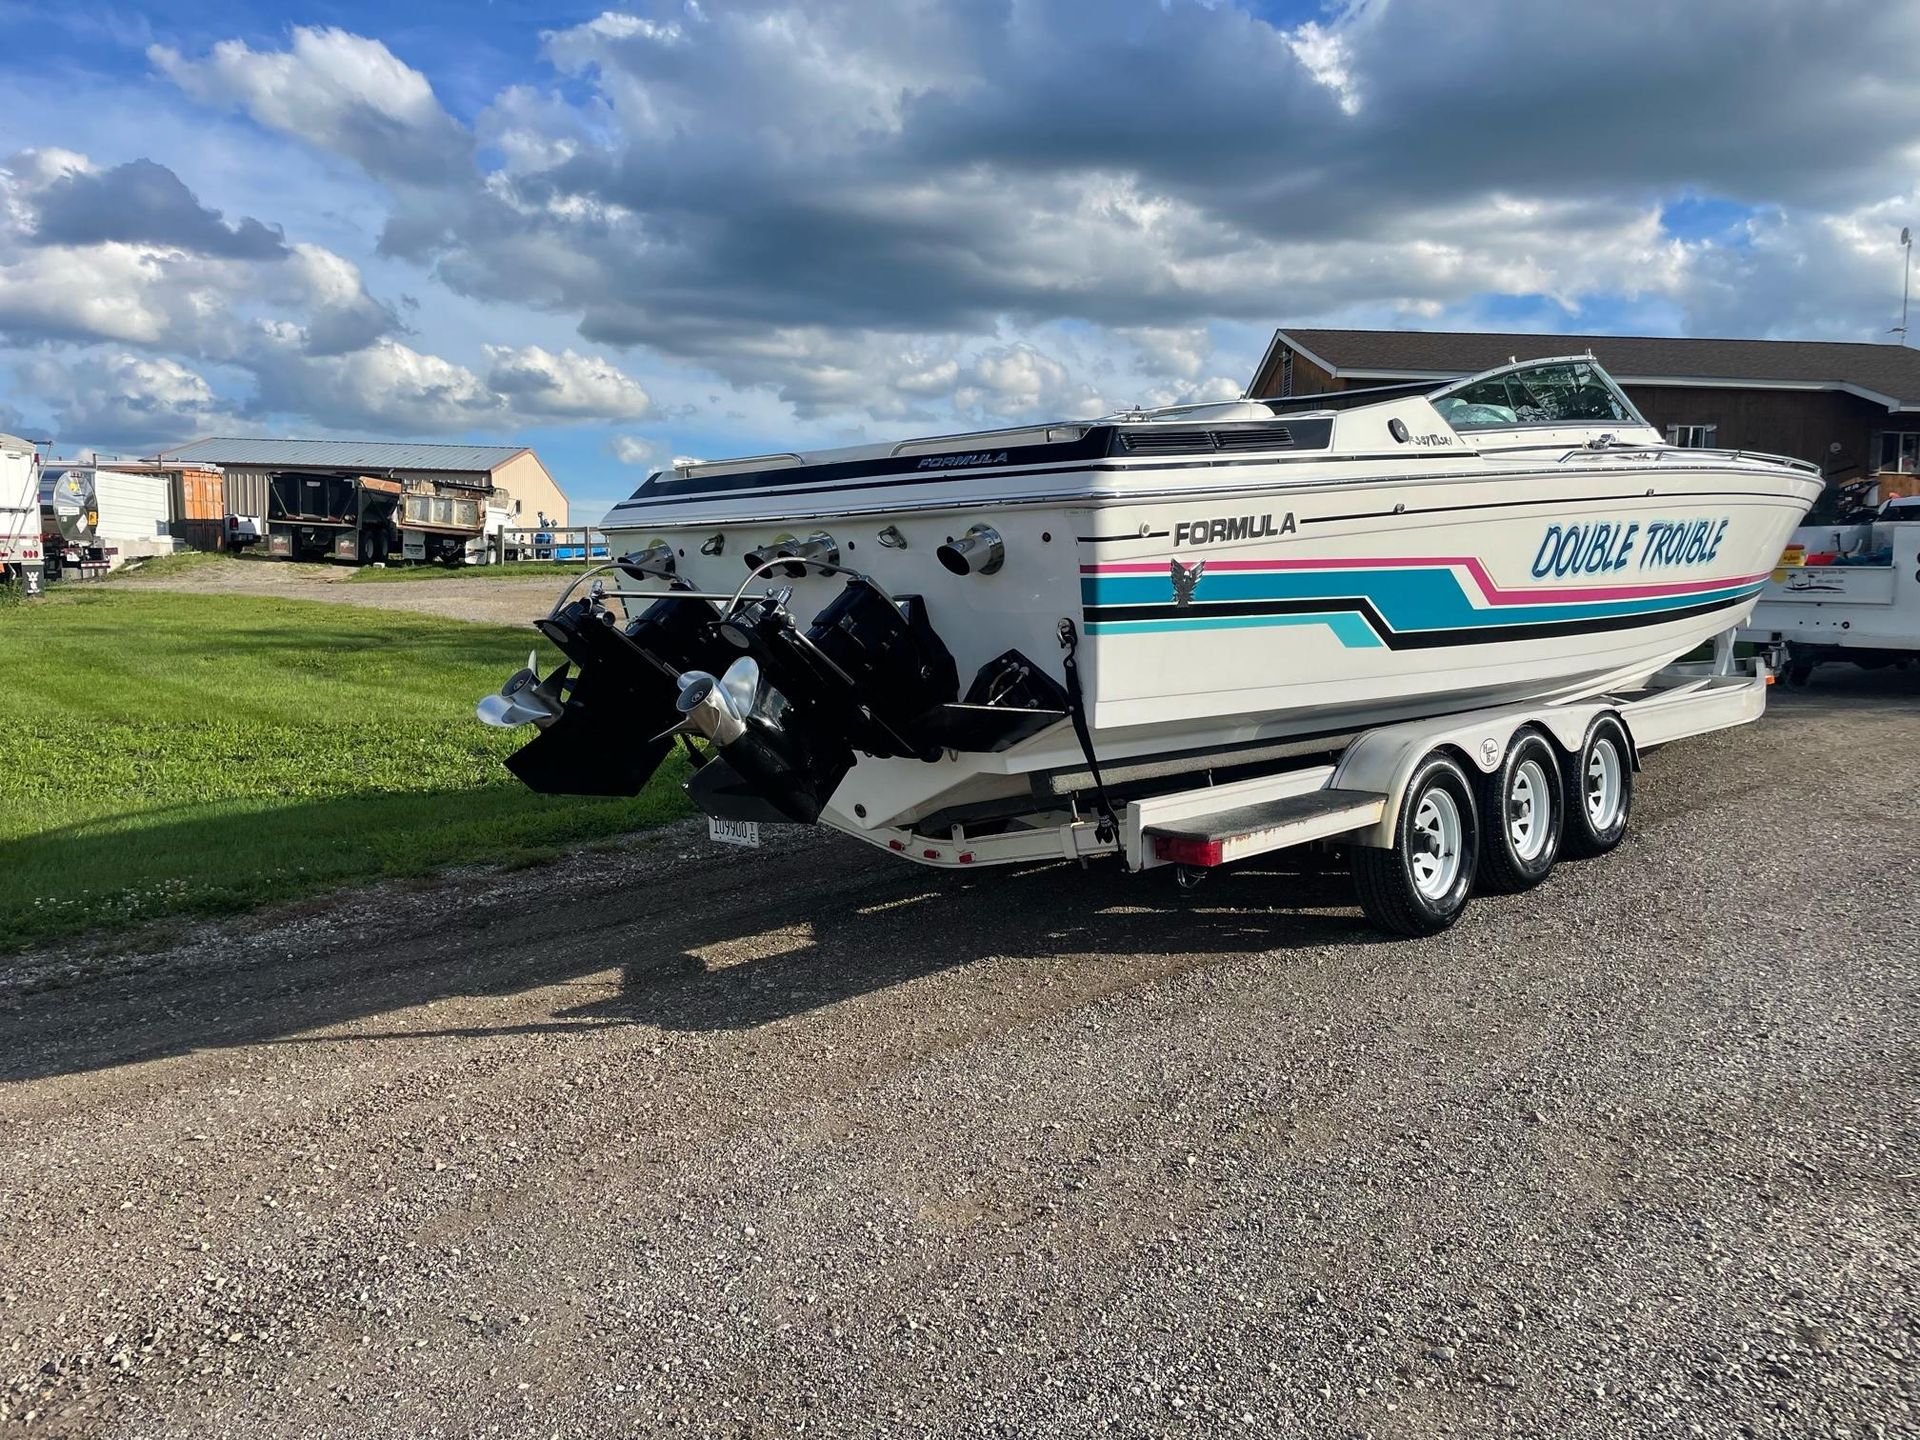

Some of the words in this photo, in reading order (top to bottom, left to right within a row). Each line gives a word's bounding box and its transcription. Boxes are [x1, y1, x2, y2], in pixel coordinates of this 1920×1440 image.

[917, 452, 1008, 469] FORMULA
[1173, 512, 1296, 547] FORMULA
[1531, 523, 1640, 578] DOUBLE
[1639, 518, 1729, 571] TROUBLE
